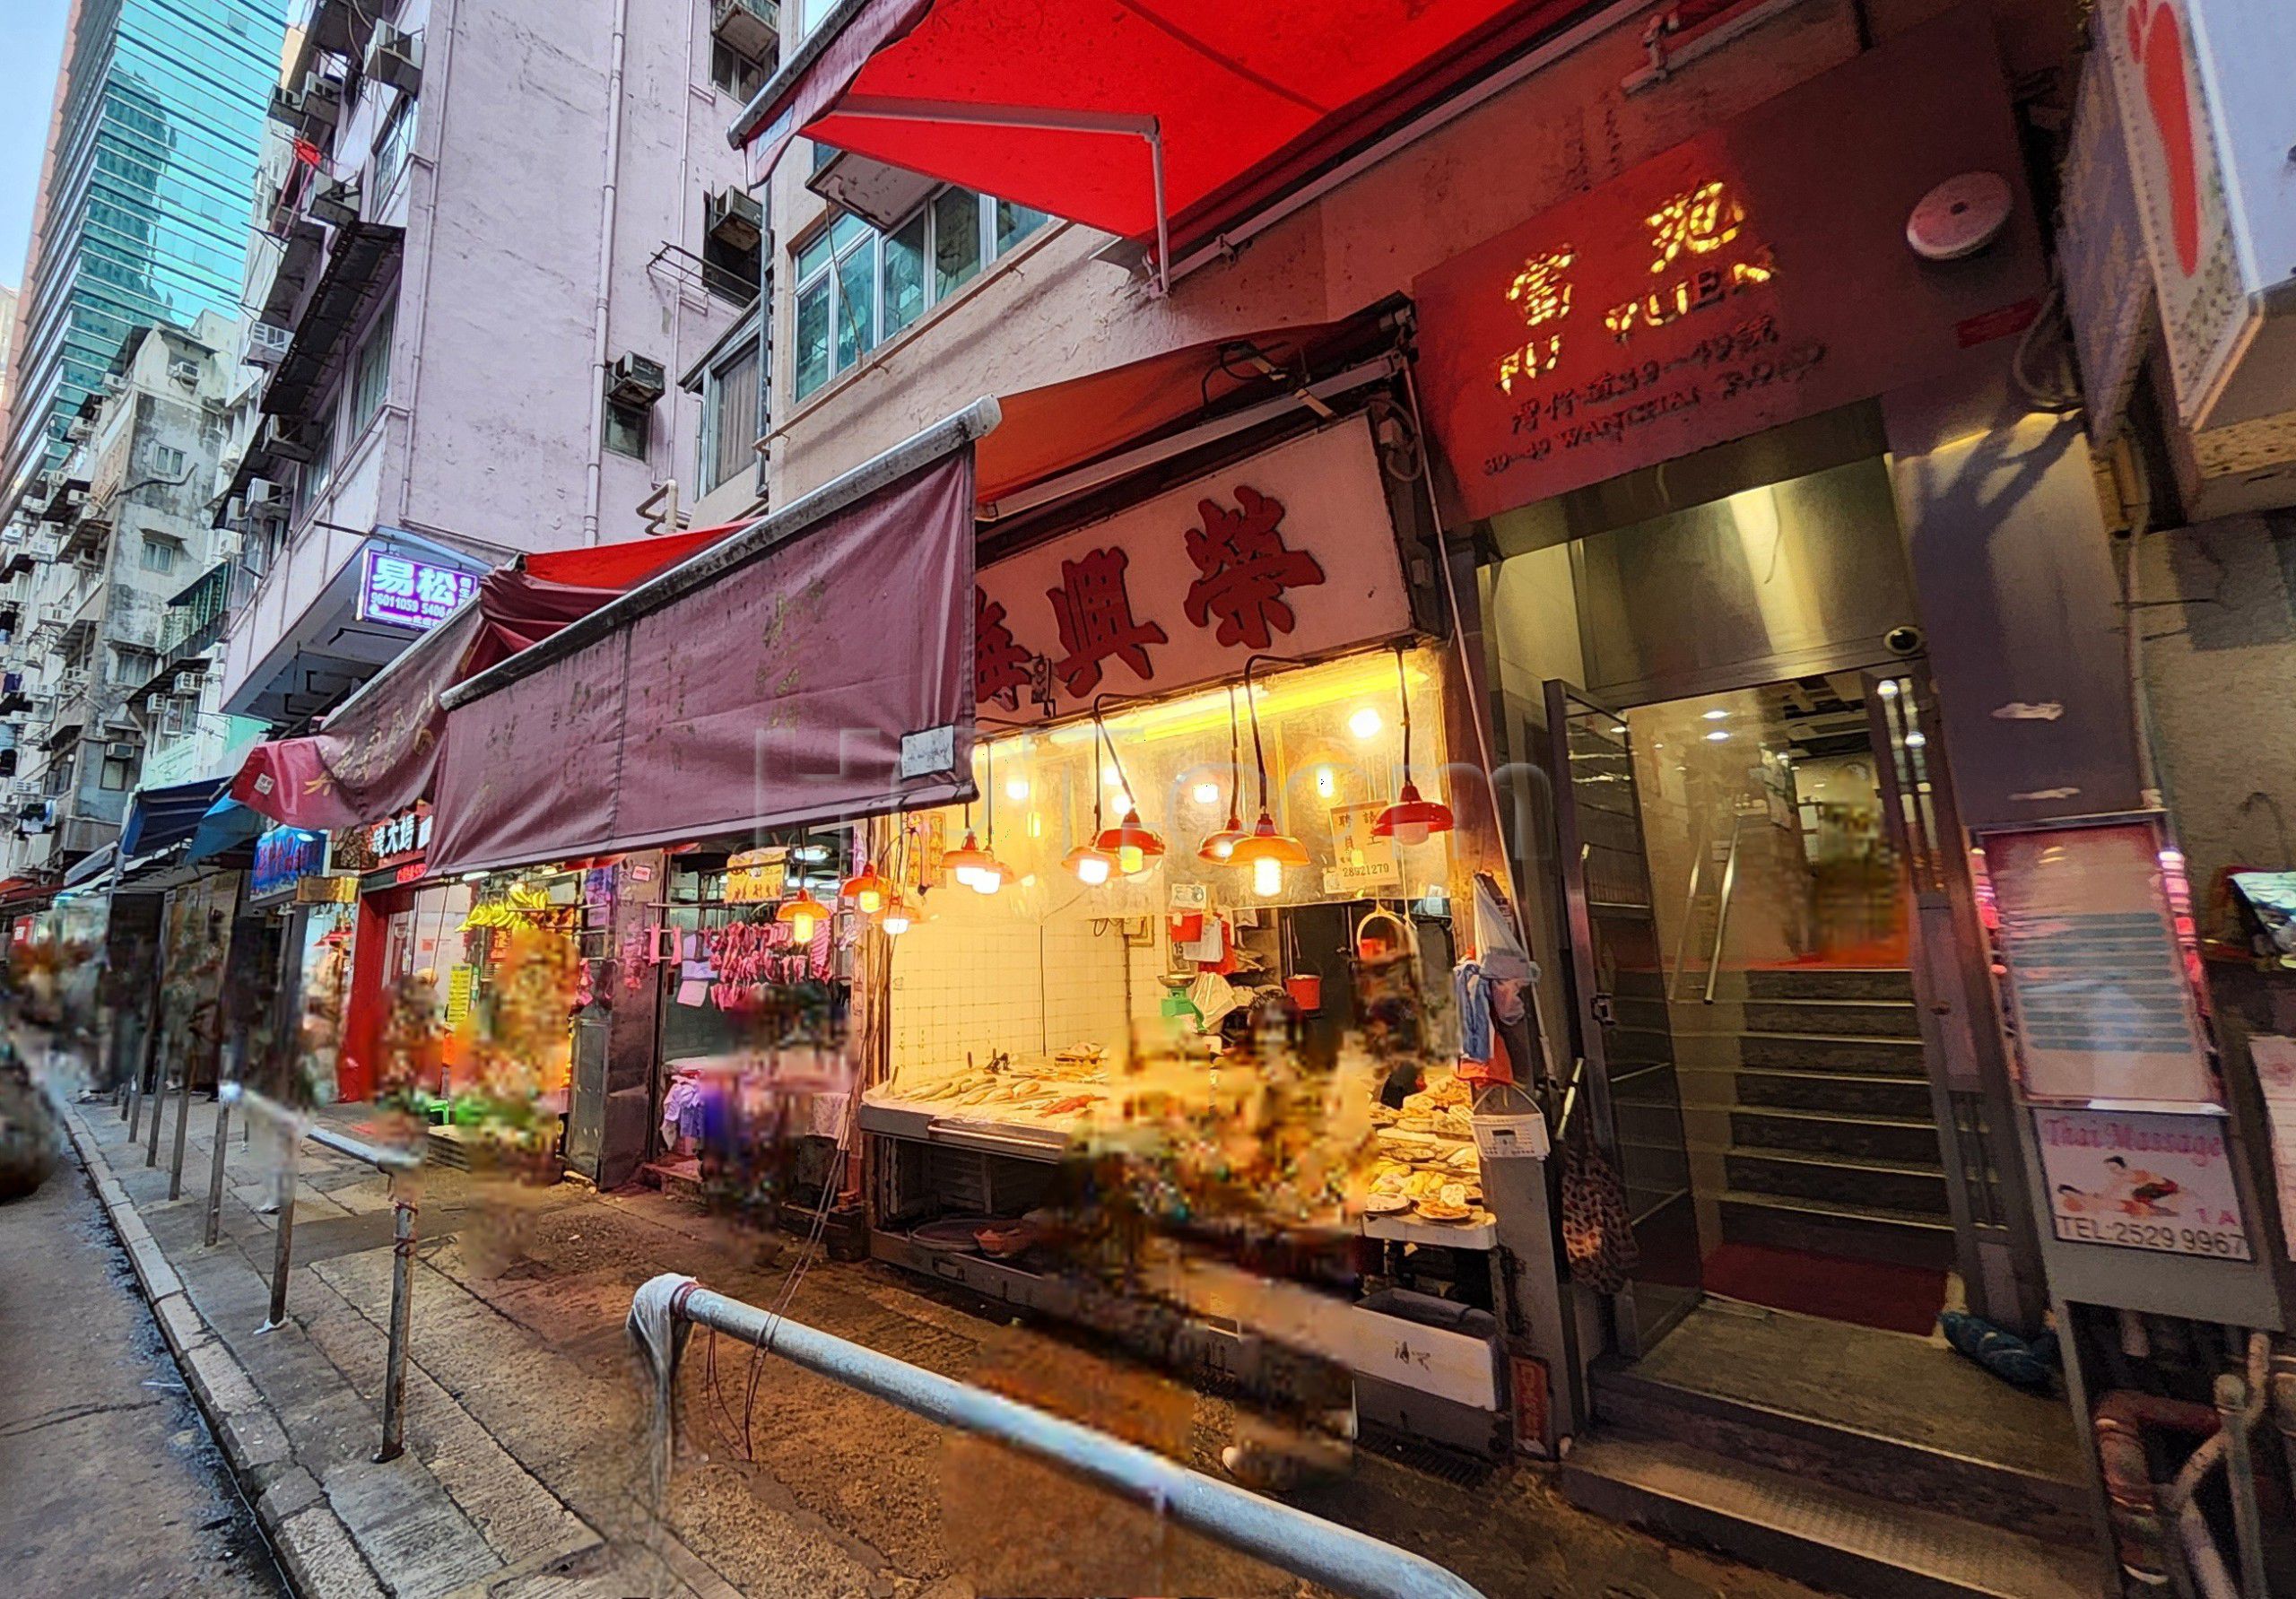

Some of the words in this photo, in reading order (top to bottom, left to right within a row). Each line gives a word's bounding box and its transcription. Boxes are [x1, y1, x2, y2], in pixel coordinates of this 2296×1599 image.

[2045, 1117, 2099, 1148] Thai
[2109, 1122, 2223, 1168] Massage
[2180, 1229, 2247, 1255] 9967
